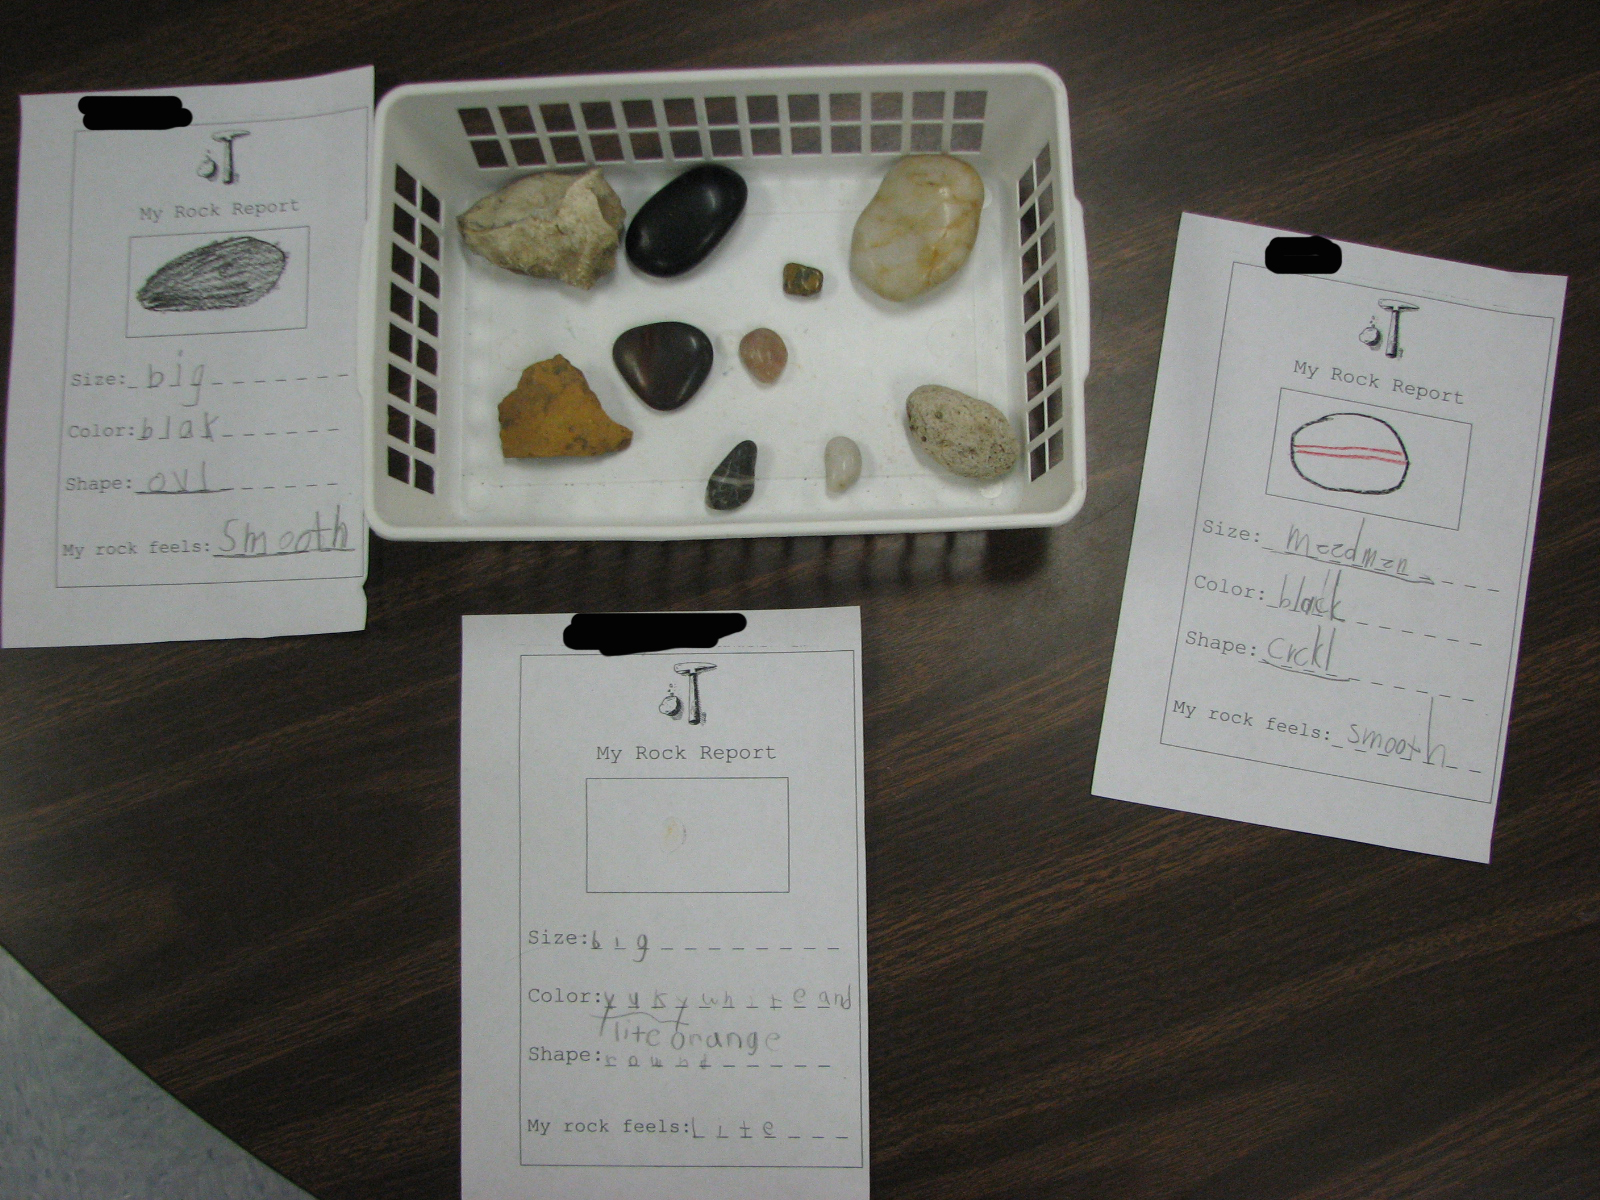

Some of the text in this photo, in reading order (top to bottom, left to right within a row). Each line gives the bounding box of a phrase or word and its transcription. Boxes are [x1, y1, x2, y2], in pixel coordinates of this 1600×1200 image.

[139, 199, 300, 224] My Rock Report
[70, 373, 126, 388] Size:
[148, 350, 205, 407] big
[1293, 360, 1464, 405] My Rock Report
[67, 424, 135, 439] Color:
[139, 411, 220, 442] blak
[65, 477, 132, 494] Shape:
[1202, 519, 1260, 543] Size:
[62, 540, 210, 560] My rock feels:
[1194, 574, 1265, 602] Color:
[1185, 630, 1257, 657] Shape:
[1173, 700, 1331, 741] My rock feels:
[596, 745, 777, 764] My Rock Report
[528, 930, 588, 946] Size:
[592, 930, 649, 963] big
[528, 988, 601, 1004] Color:
[819, 985, 851, 1010] and
[615, 1019, 781, 1056] lite orange
[528, 1047, 601, 1065] Shape:
[527, 1119, 690, 1136] My rock feels:
